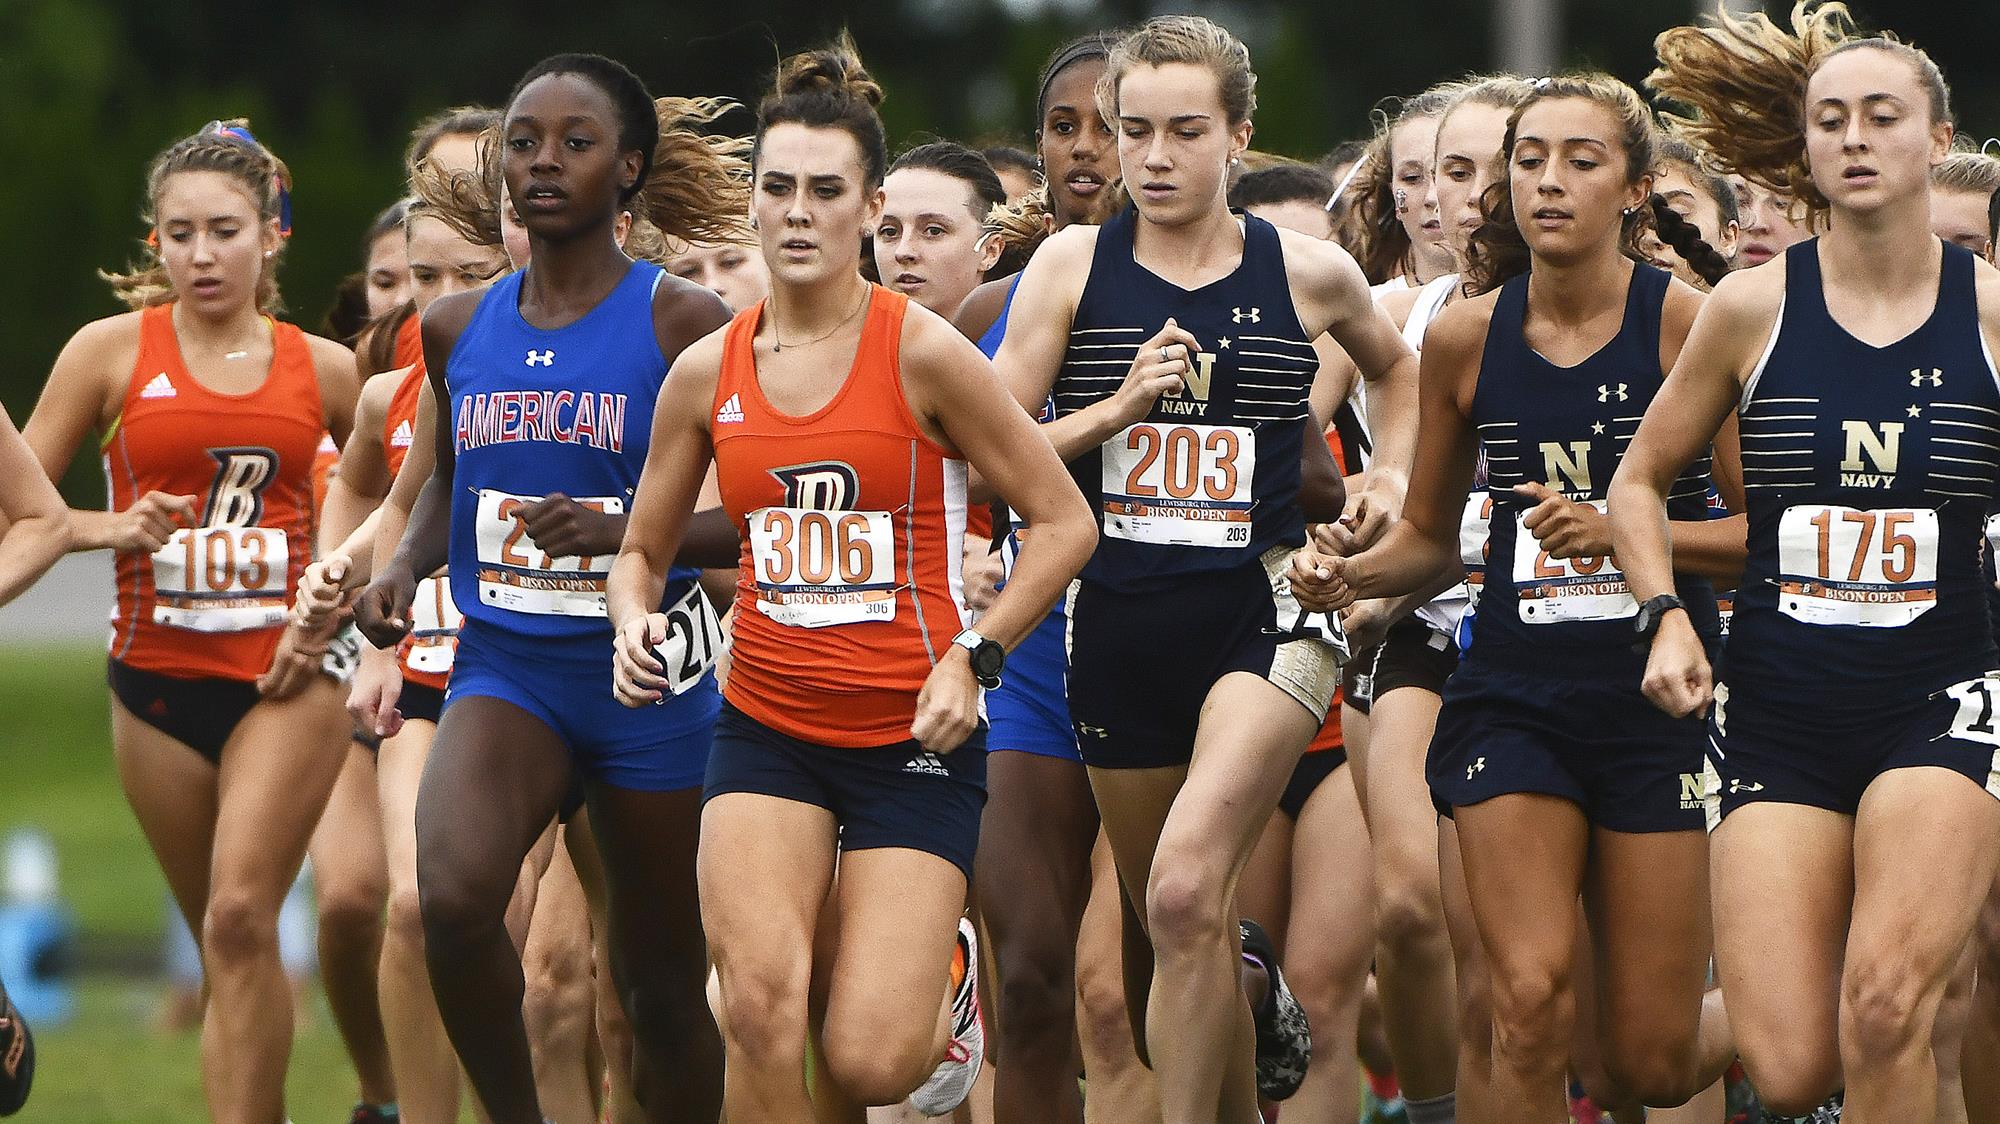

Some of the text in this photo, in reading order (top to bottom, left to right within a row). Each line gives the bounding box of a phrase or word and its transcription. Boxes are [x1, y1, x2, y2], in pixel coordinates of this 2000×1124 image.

[455, 389, 627, 456] AMERICAN
[1160, 400, 1208, 416] NAVY
[1125, 425, 1240, 500] 203
[1840, 420, 1905, 473] N
[1539, 441, 1592, 492] N
[1839, 473, 1896, 489] NAVY
[1147, 507, 1227, 521] BISON OPEN
[764, 510, 873, 584] 306
[1226, 527, 1247, 542] 203
[1810, 509, 1917, 583] 175
[179, 529, 269, 592] 103
[782, 592, 825, 605] BISON
[1556, 581, 1630, 597] BISON OPE
[1825, 588, 1906, 603] BISON OPEN
[865, 602, 888, 614] 306
[665, 588, 725, 684] 27
